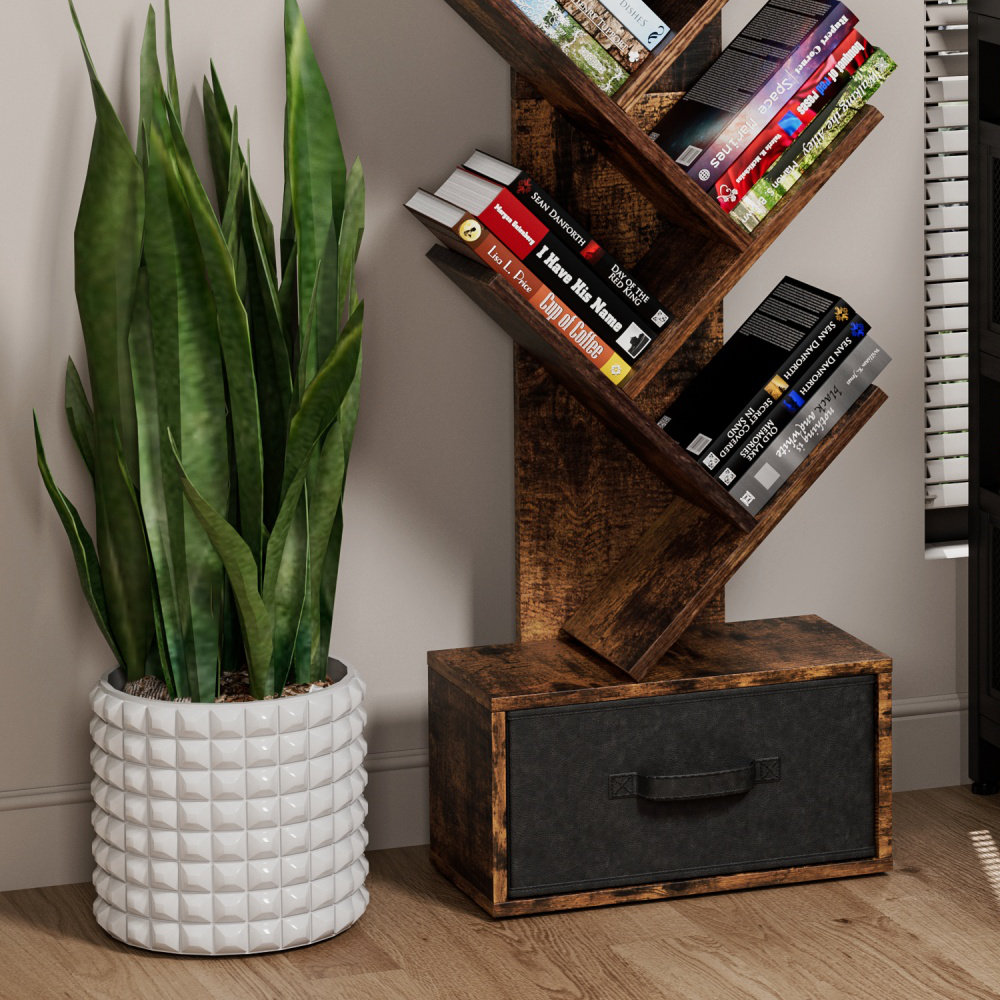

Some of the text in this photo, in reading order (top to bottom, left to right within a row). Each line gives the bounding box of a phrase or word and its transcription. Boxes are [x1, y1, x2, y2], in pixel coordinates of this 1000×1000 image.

[619, 0, 648, 26] DISHES
[792, 15, 848, 75] Rupert Cornet
[755, 78, 794, 117] Space
[796, 41, 864, 115] bouquet of red roses
[802, 69, 882, 157] Walking the Alley
[710, 115, 759, 168] Marines
[530, 192, 586, 246] SEAN DANFORTH
[740, 196, 767, 222] Brwn
[487, 245, 532, 292] Lisa L. Price
[536, 245, 622, 332] I Have His Name
[608, 272, 643, 306] RED KING
[611, 264, 650, 303] DAY OF THE
[539, 292, 603, 358] Cup of Coffee
[783, 321, 836, 380] SEAN DANFORTH
[799, 336, 852, 395] SEAN DANFORTH
[720, 398, 773, 458] SECRET COVERED
[727, 407, 755, 438] IN SAND
[740, 419, 774, 457] MEMORIES
[744, 424, 778, 461] OLD LAKE
[776, 384, 844, 457] black and white
[793, 405, 834, 452] nothing is
